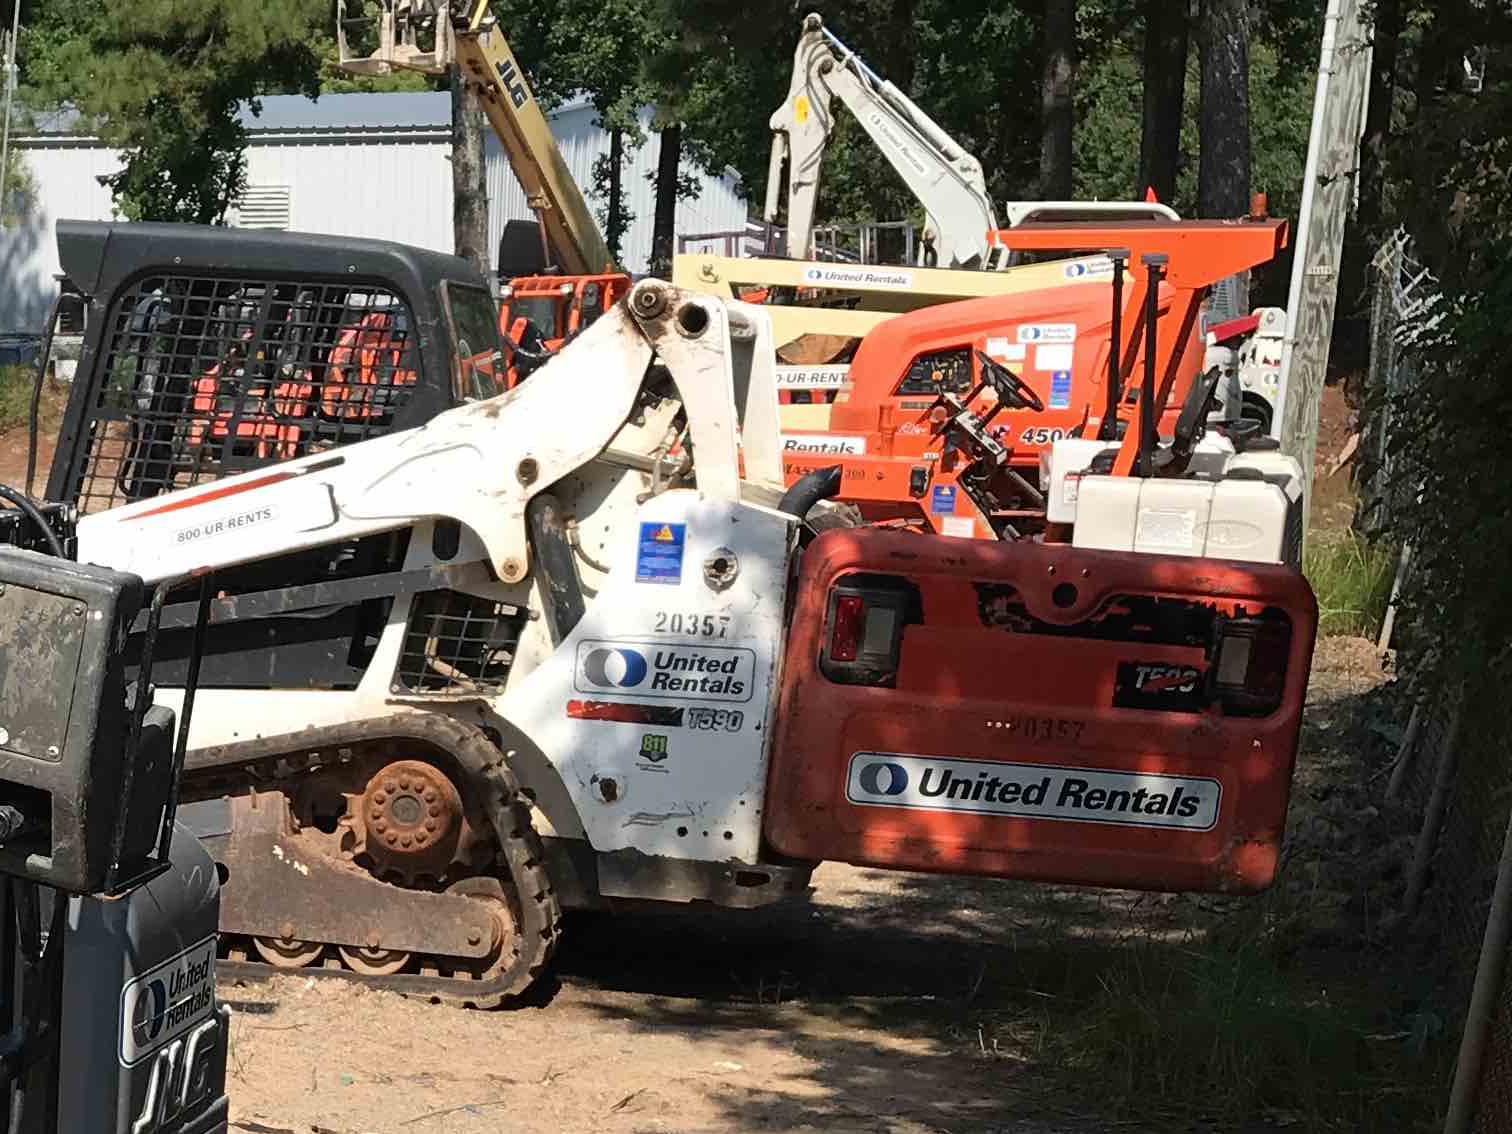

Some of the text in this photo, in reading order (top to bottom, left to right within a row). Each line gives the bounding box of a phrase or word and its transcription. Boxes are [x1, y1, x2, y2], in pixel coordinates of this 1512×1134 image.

[495, 59, 528, 109] JLG
[824, 271, 907, 285] United Rentals
[784, 440, 855, 455] Rentals
[654, 611, 730, 638] 20357
[654, 650, 738, 675] United
[651, 672, 745, 695] Rentals
[688, 707, 744, 732] T590
[918, 767, 1202, 819] United Rentals
[169, 951, 212, 998] United
[166, 984, 212, 1030] Rentals
